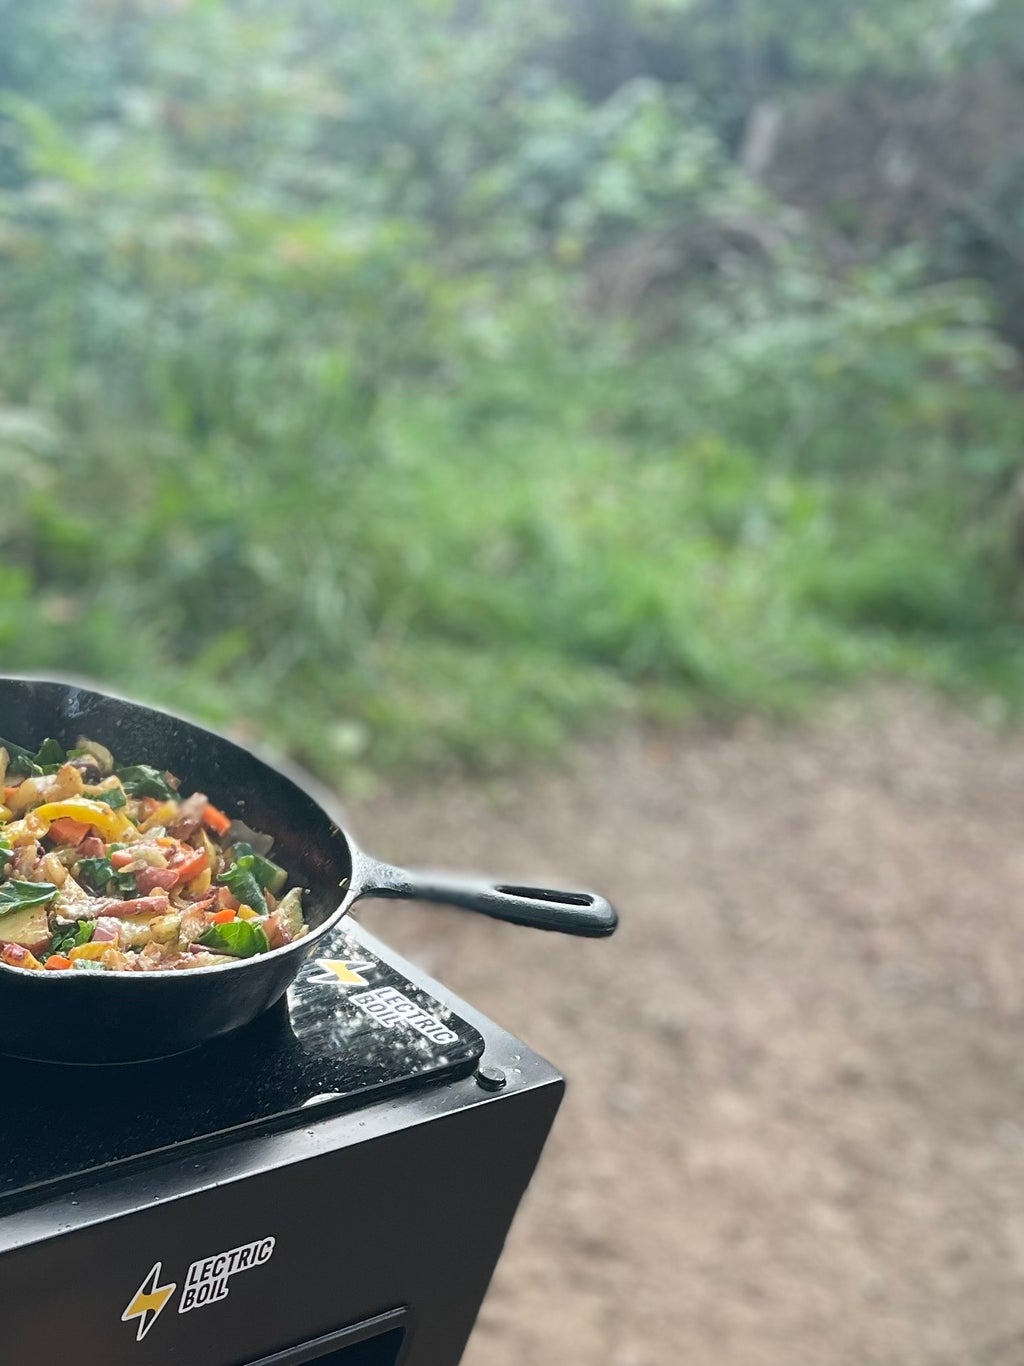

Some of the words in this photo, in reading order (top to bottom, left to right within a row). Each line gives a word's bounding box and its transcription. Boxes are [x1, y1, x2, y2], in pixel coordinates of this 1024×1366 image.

[356, 994, 397, 1026] BOIL
[375, 987, 455, 1043] LECTRIC
[187, 1239, 273, 1287] LECTRIC
[181, 1276, 228, 1311] BOIL
